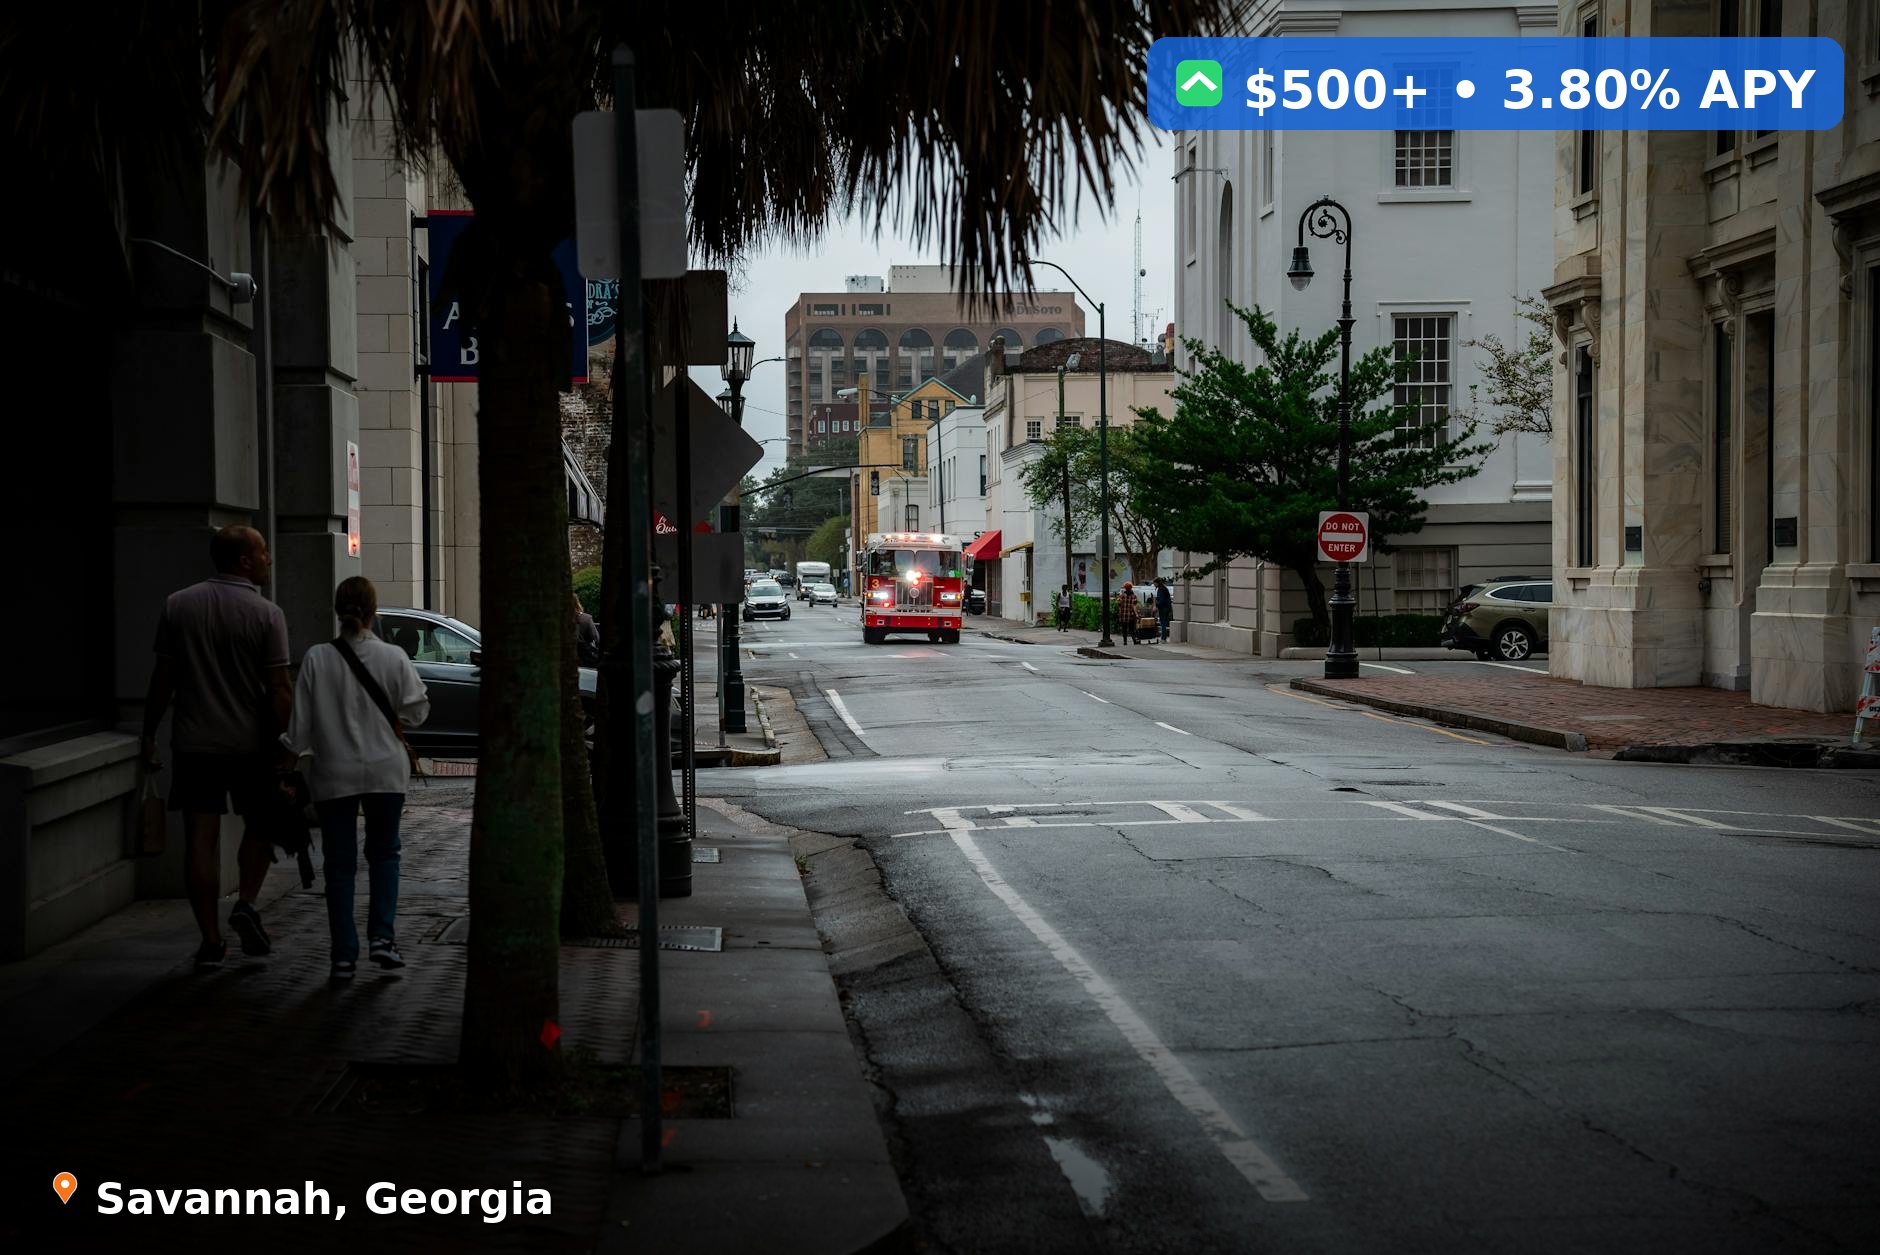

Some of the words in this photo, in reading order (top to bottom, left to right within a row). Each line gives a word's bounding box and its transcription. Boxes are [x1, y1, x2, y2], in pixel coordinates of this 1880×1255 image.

[1326, 522, 1338, 531] DO
[1341, 522, 1360, 531] NOT
[1328, 543, 1356, 552] ENTER
[871, 578, 880, 589] 3
